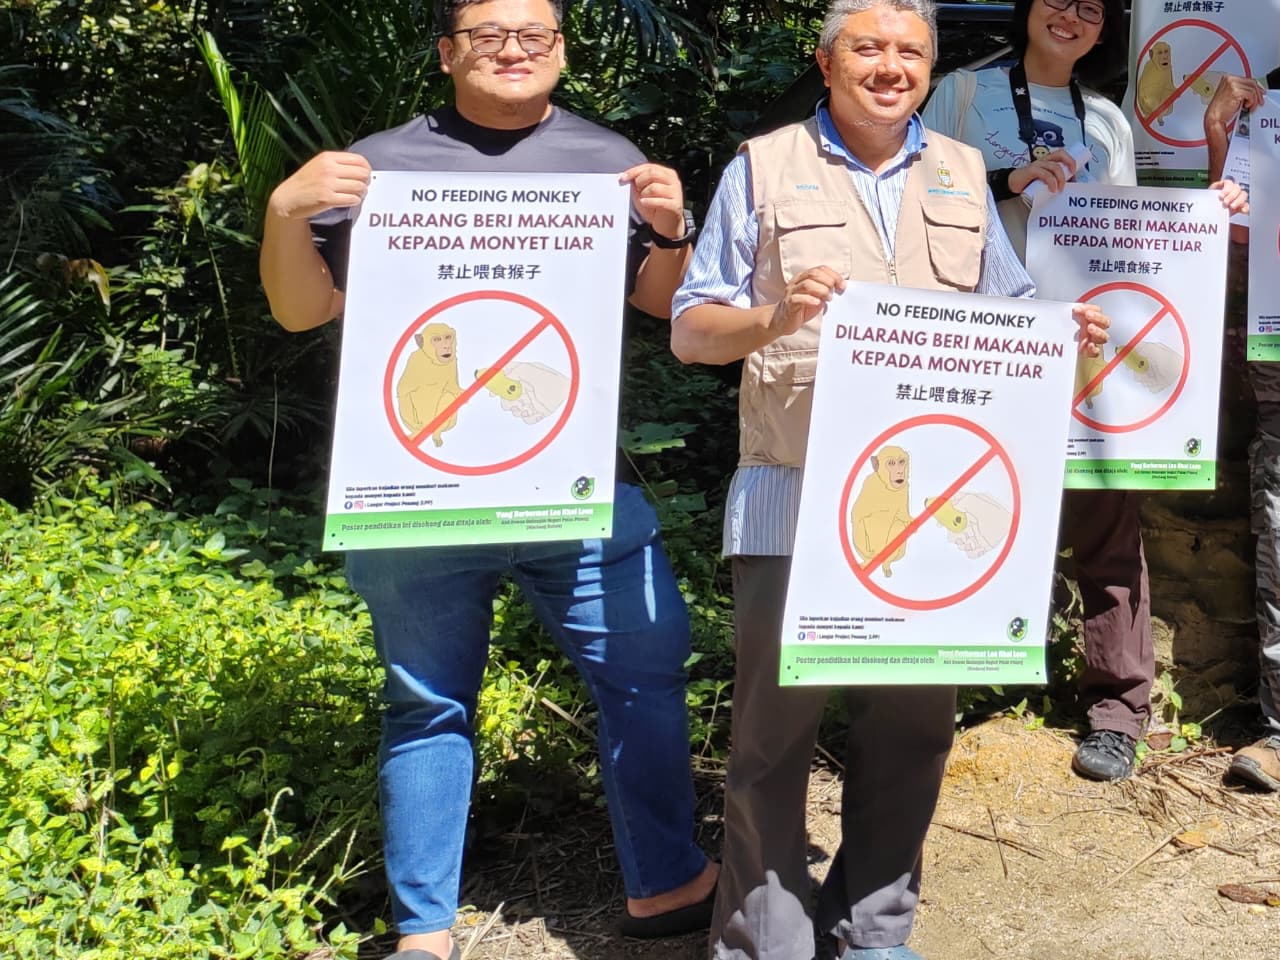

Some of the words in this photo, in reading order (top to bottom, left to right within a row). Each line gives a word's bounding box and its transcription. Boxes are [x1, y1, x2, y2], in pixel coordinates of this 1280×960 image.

[412, 190, 436, 202] NO
[442, 190, 507, 202] FEEDING
[512, 191, 581, 203] MONKEY
[1069, 197, 1087, 208] NO
[1090, 198, 1138, 210] FEEDING
[1141, 201, 1193, 213] MONKEY
[369, 213, 468, 228] DILARANG
[474, 214, 512, 228] BERI
[518, 214, 614, 228] MAKANAN
[1039, 217, 1109, 229] DILARANG
[1114, 219, 1141, 230] BERI
[1146, 221, 1218, 234] MAKANAN
[388, 236, 464, 250] KEPADA
[470, 236, 550, 250] MONYET
[554, 237, 594, 250] LIAR
[1054, 234, 1108, 248] KEPADA
[1112, 238, 1169, 250] MONYET
[1172, 240, 1202, 252] LIAR
[438, 264, 541, 280] 禁止喂食猴子
[1088, 260, 1163, 275] 禁止喂食猴子
[876, 302, 900, 316] NO
[904, 305, 966, 322] FEEDING
[970, 311, 1036, 329] MONKEY
[836, 324, 927, 346] DILARANG
[933, 333, 969, 349] BERI
[973, 338, 1063, 357] MAKANAN
[852, 350, 922, 369] KEPADA
[928, 357, 1001, 376] MONYET
[1006, 363, 1043, 379] LIAR
[896, 384, 993, 406] 禁止喂食猴子
